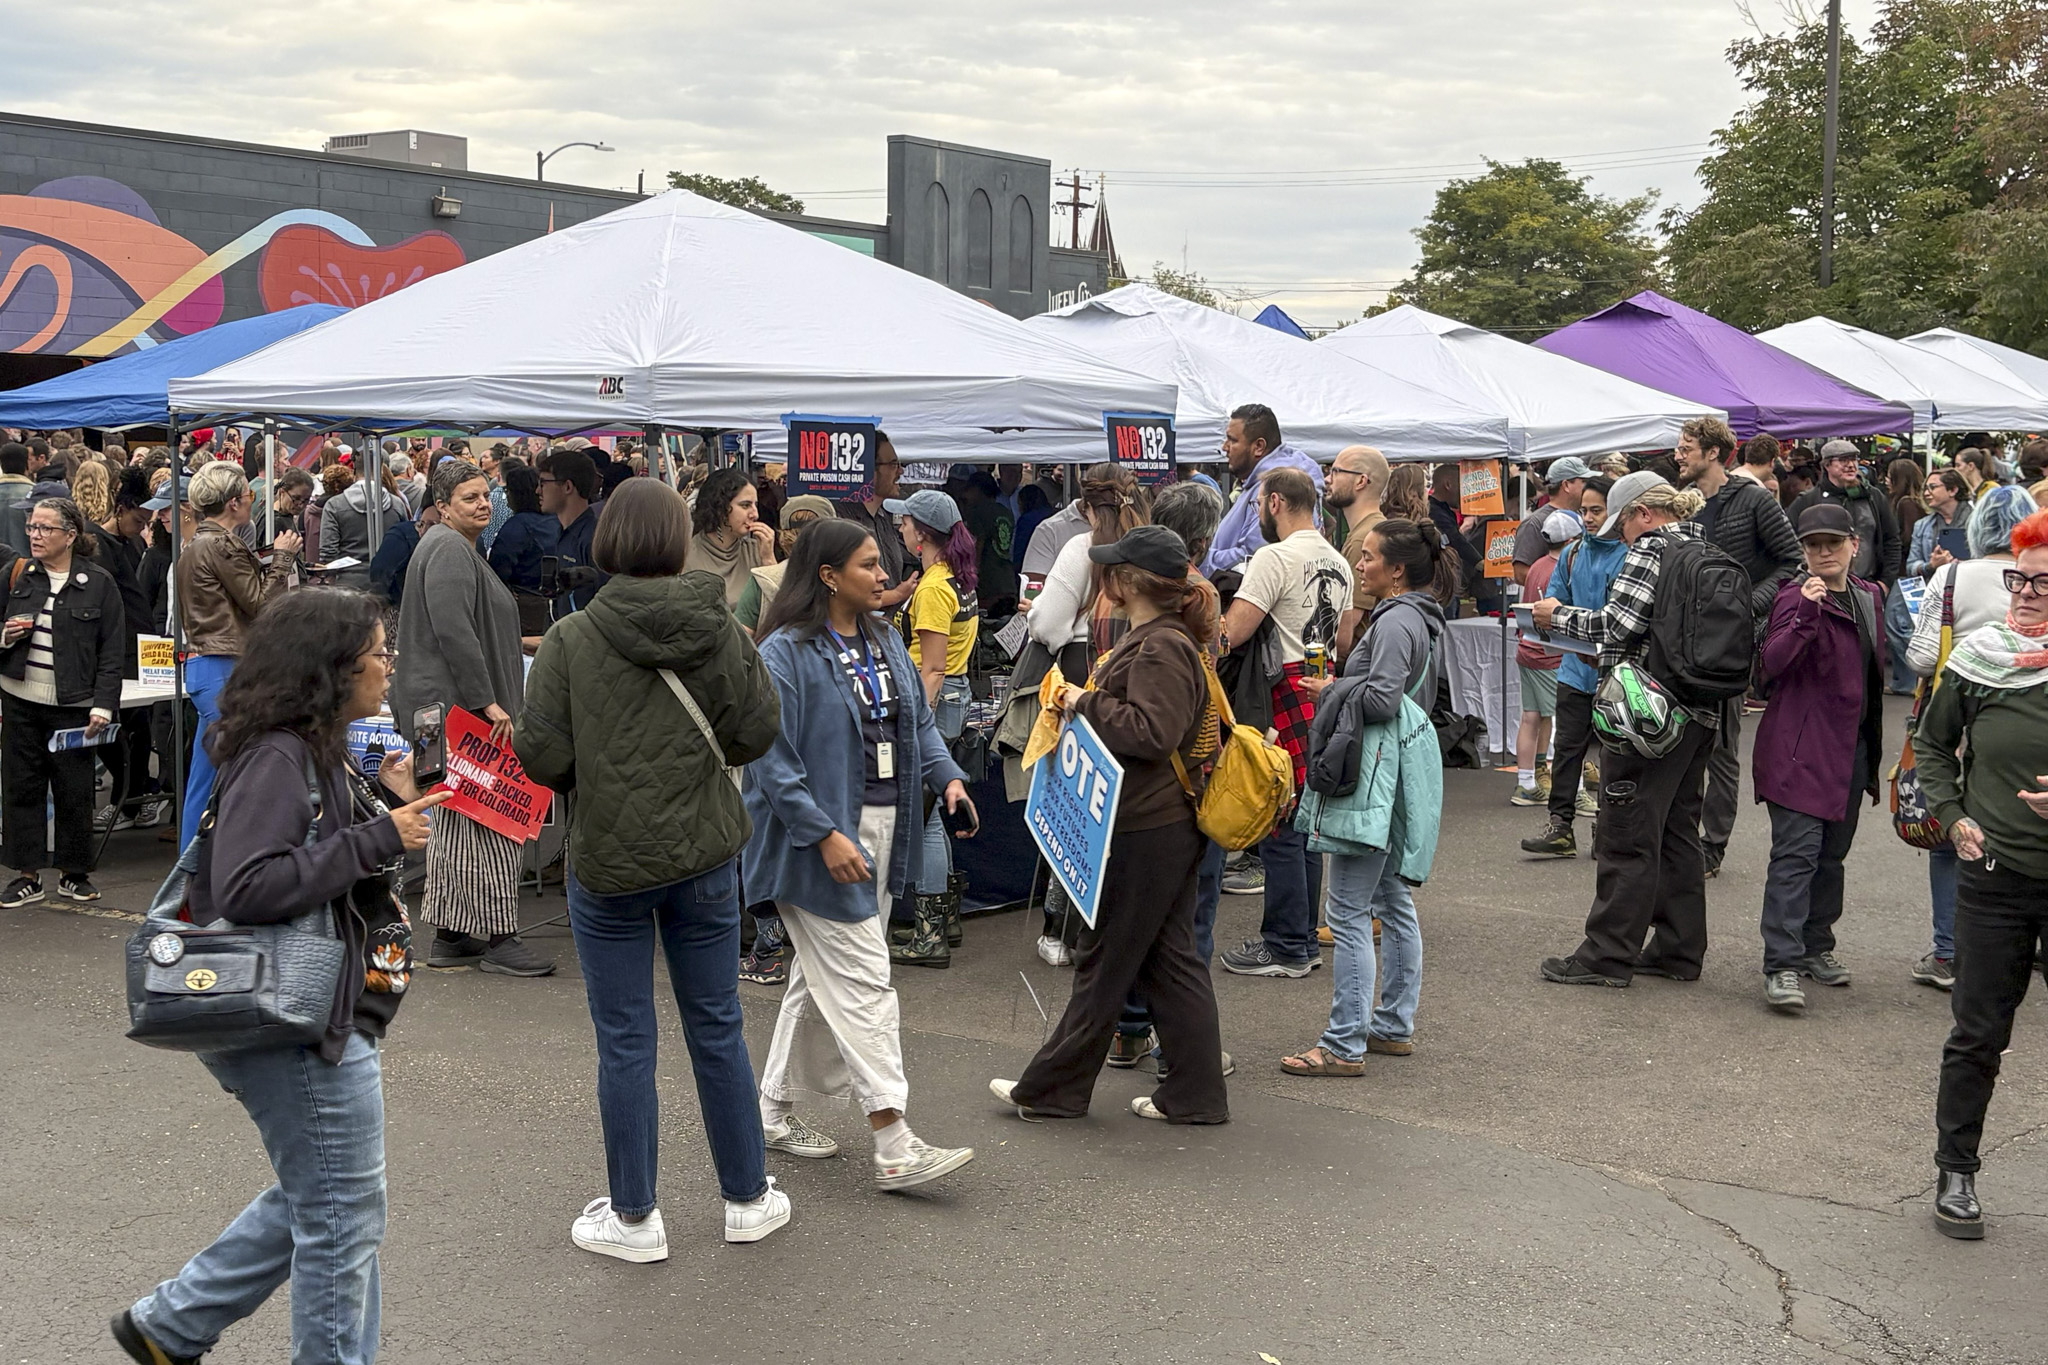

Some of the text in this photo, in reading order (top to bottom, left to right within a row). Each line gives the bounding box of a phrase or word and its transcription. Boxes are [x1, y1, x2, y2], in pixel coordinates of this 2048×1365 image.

[599, 376, 623, 395] ABC
[799, 472, 864, 483] PRIVATE PRISON CASH GRAB
[458, 732, 501, 766] PROP
[446, 753, 532, 810] LLIONAIRE BACKED.
[1061, 728, 1108, 825] OTE
[458, 779, 480, 801] FOR
[478, 789, 531, 828] COLORADO.
[1060, 802, 1089, 854] FUTURES
[1062, 785, 1087, 830] RIGHTS
[1034, 807, 1063, 861] DEPEND
[1063, 856, 1078, 885] ON
[1076, 876, 1089, 900] IT
[1055, 819, 1093, 881] FREEDOMS
